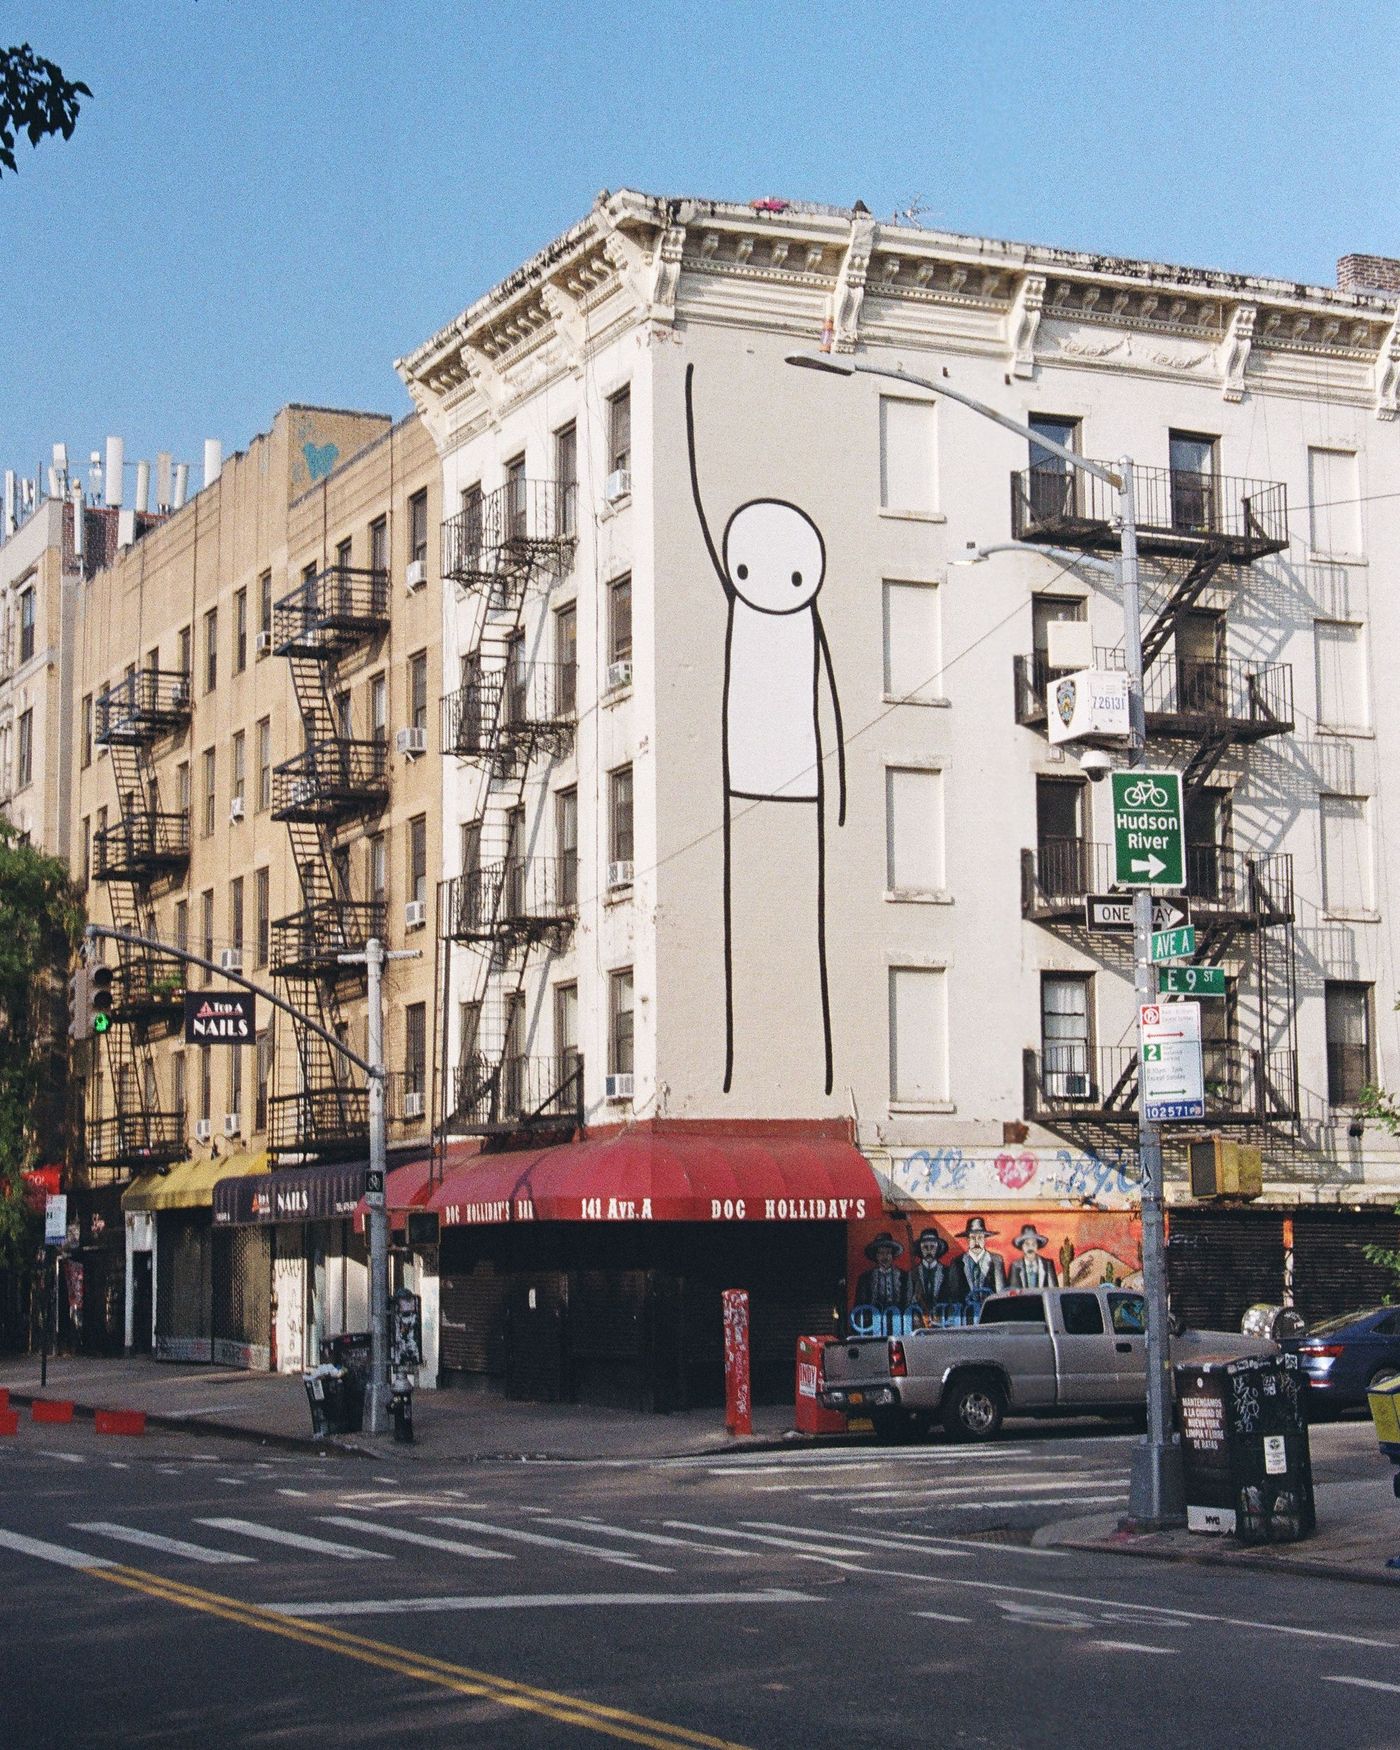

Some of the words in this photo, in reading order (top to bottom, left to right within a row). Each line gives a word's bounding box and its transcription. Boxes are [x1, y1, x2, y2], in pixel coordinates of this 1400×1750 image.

[1092, 695, 1125, 710] 726131
[1117, 813, 1178, 831] Hudson
[1128, 833, 1169, 850] River
[1102, 906, 1130, 921] ONE
[1156, 933, 1176, 958] AVE
[1182, 930, 1190, 951] A
[1168, 969, 1178, 991] E
[1186, 969, 1197, 991] 9
[1204, 970, 1214, 982] ST
[193, 1018, 248, 1037] NAILS
[1147, 1044, 1157, 1060] 2
[277, 1190, 308, 1212] NAILS
[581, 1198, 602, 1219] 141
[711, 1199, 746, 1219] DOC
[765, 1199, 866, 1219] HOLLIDAY'S
[445, 1205, 460, 1223] DOC
[466, 1200, 510, 1223] HOLLIDAY'S
[518, 1200, 534, 1219] BAR
[1205, 1515, 1220, 1526] NYC
